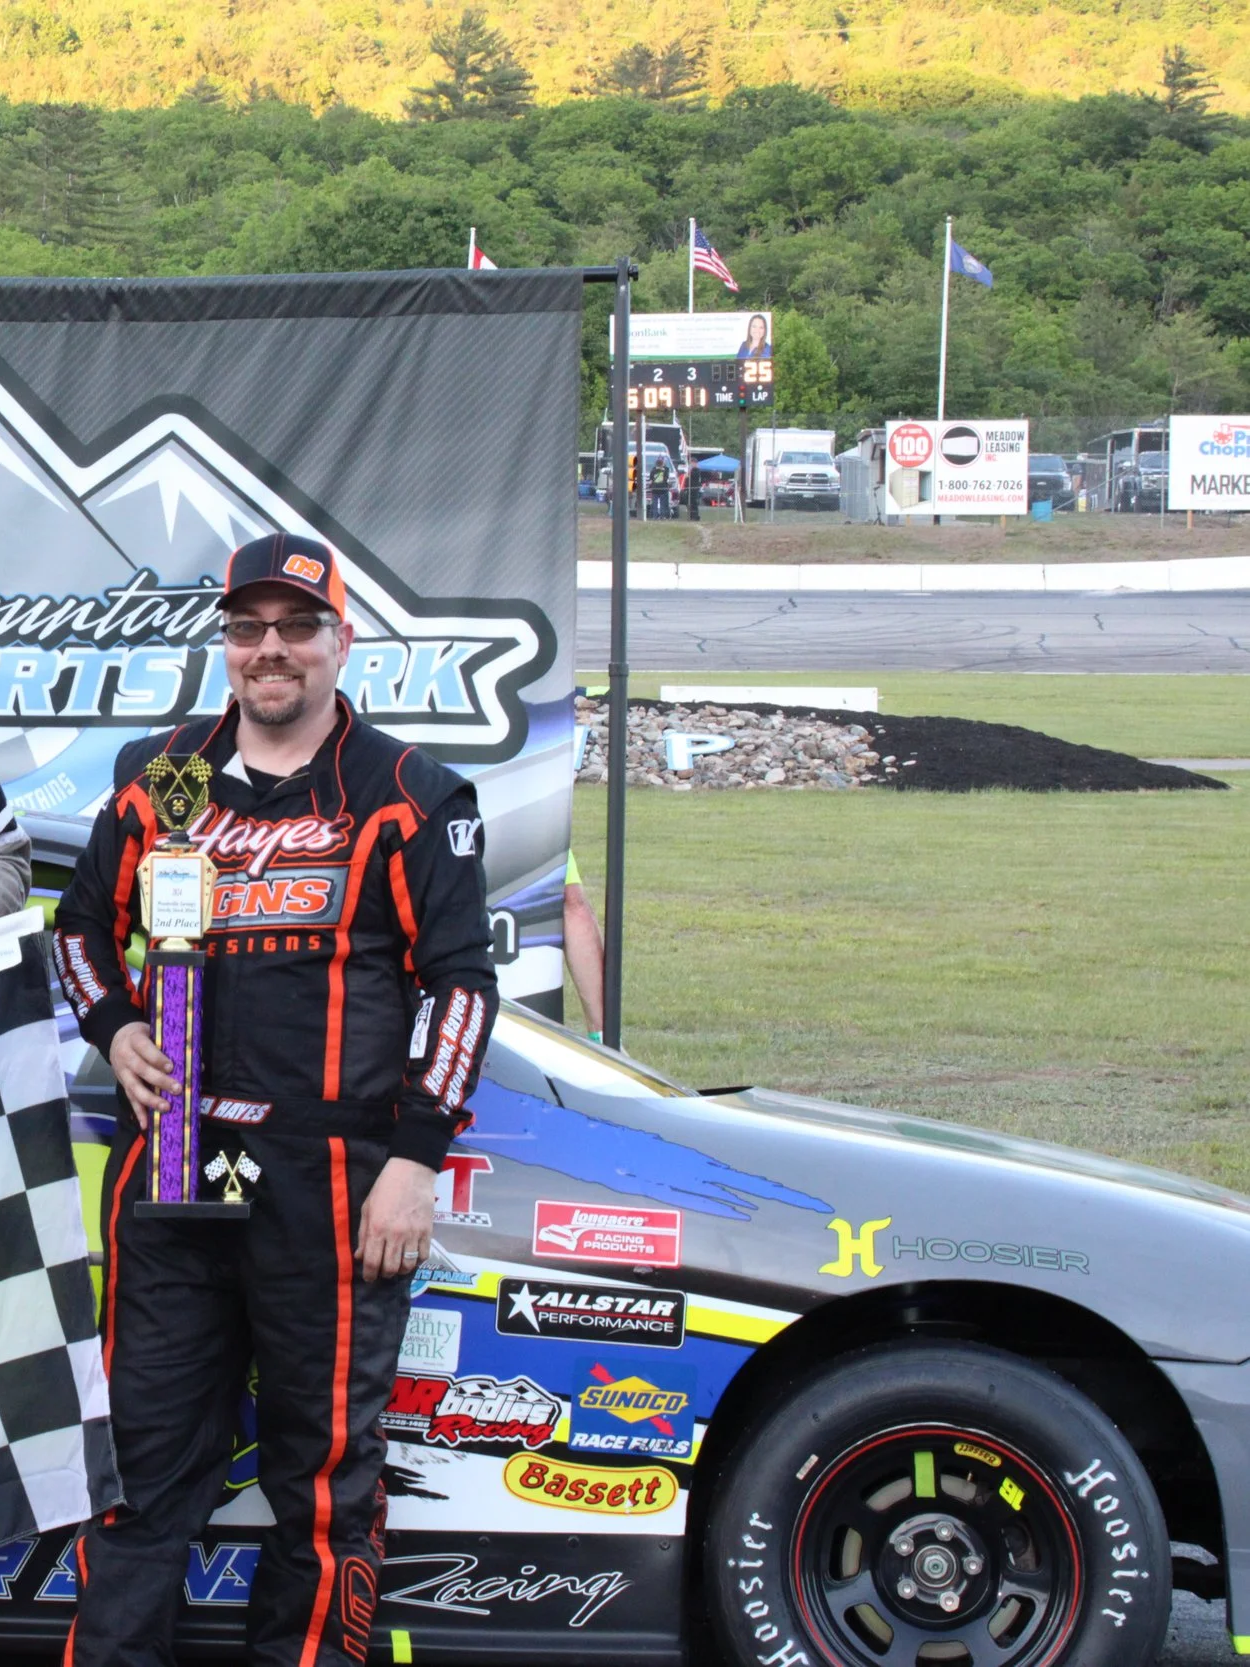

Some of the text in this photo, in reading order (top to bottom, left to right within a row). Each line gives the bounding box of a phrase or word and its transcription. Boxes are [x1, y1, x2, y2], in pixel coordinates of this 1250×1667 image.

[653, 368, 663, 382] 2
[687, 367, 697, 381] 3
[744, 361, 772, 383] 25
[715, 392, 733, 402] TIME
[752, 391, 768, 401] LAP
[985, 431, 1025, 441] MEADOW
[985, 442, 1021, 453] LEASING
[938, 480, 1023, 490] 1-800-762-7026
[937, 494, 1024, 502] MEADOWLEASING.COM
[284, 555, 324, 582] 09
[155, 806, 343, 877] Hayes
[209, 877, 333, 920] GNS
[154, 918, 200, 928] 2nd Place
[441, 990, 468, 1042] Hayes
[212, 1100, 271, 1123] HAYES
[571, 1209, 646, 1227] Longacre
[583, 1241, 655, 1254] PRODUCTS
[594, 1233, 645, 1245] RACING
[892, 1236, 1091, 1275] HOOSIER
[536, 1291, 675, 1317] ALLSTAR
[538, 1311, 674, 1333] PERFORMANCE
[584, 1388, 684, 1412] SUNOCO
[426, 1413, 555, 1446] Racing
[570, 1432, 691, 1455] RACE FUELS
[519, 1460, 663, 1508] Bassett
[381, 1552, 634, 1627] Racing
